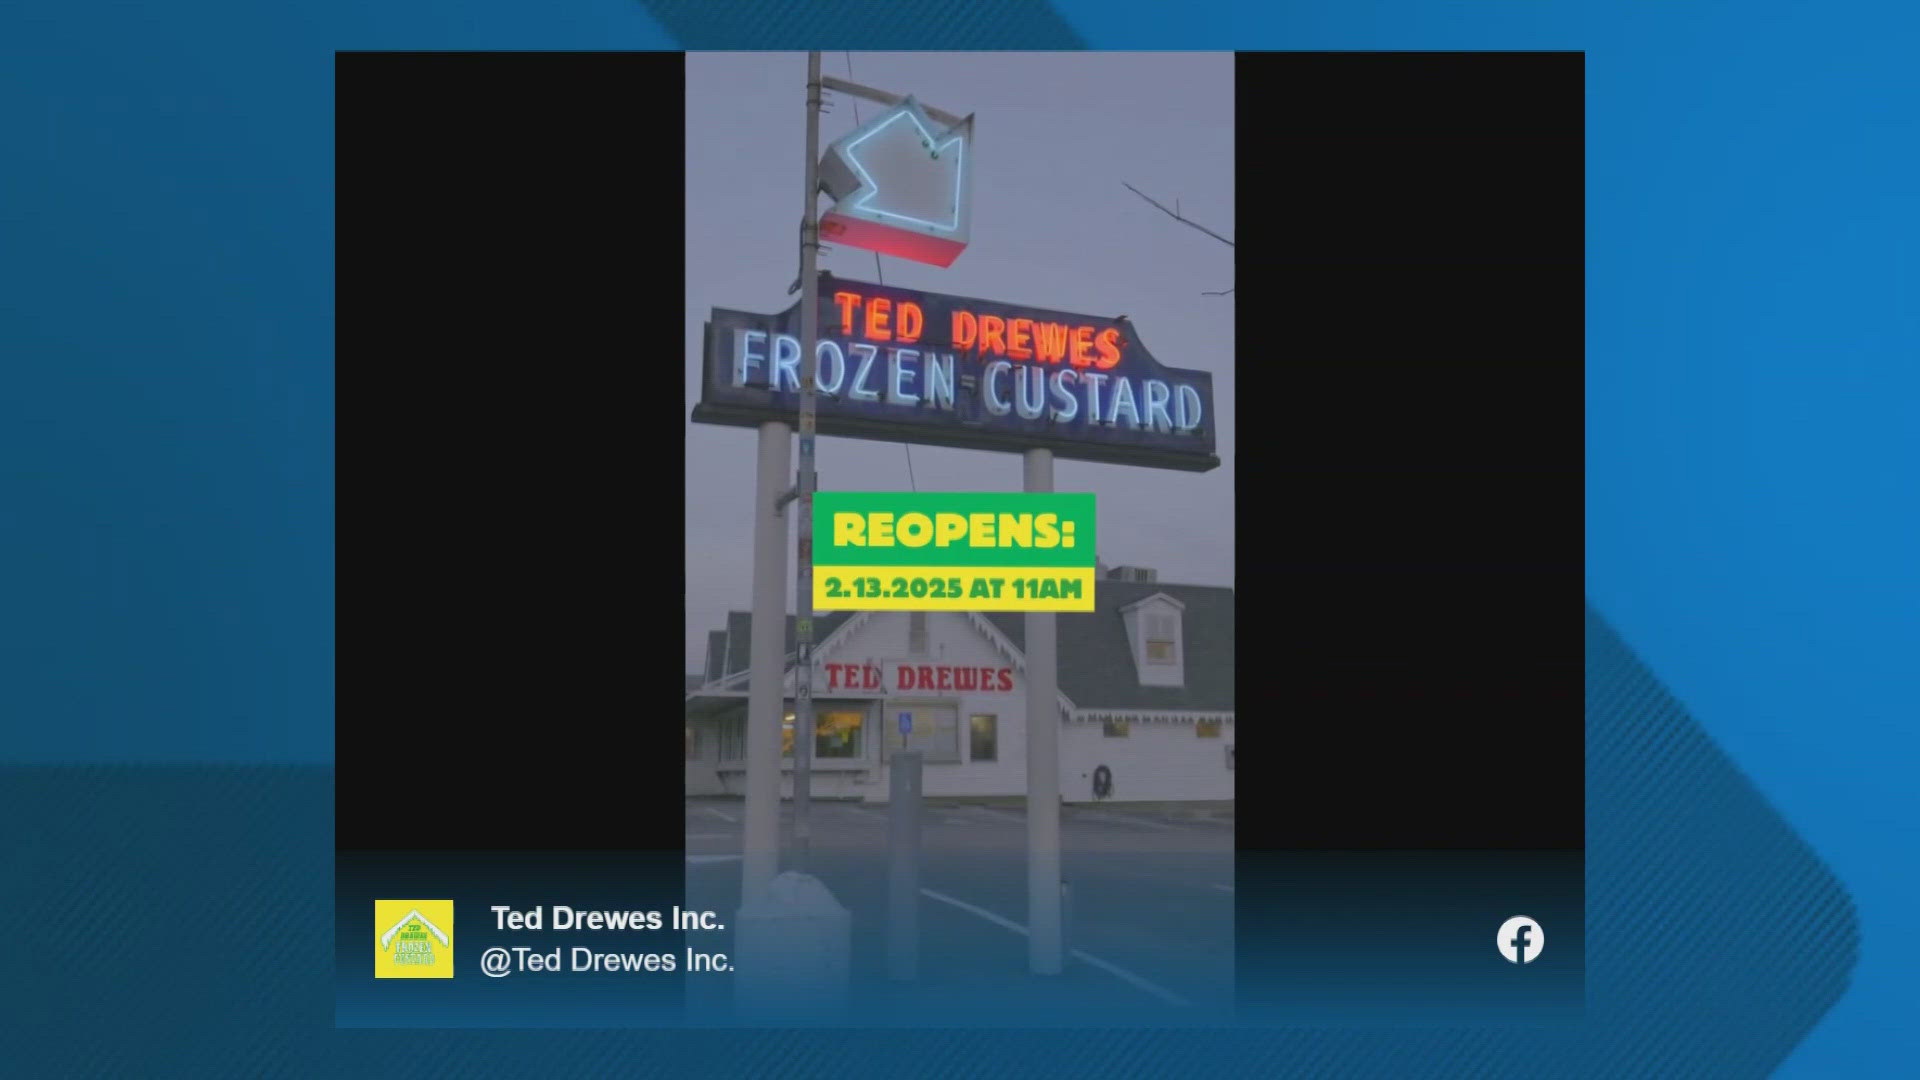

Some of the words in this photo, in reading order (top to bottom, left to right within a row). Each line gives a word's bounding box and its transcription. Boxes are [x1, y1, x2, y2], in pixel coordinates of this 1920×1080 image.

[833, 290, 923, 342] TED
[951, 310, 1122, 369] DREWES
[733, 330, 956, 409] FROZEN
[983, 360, 1203, 434] CUSTARD
[897, 666, 1013, 692] DREWES
